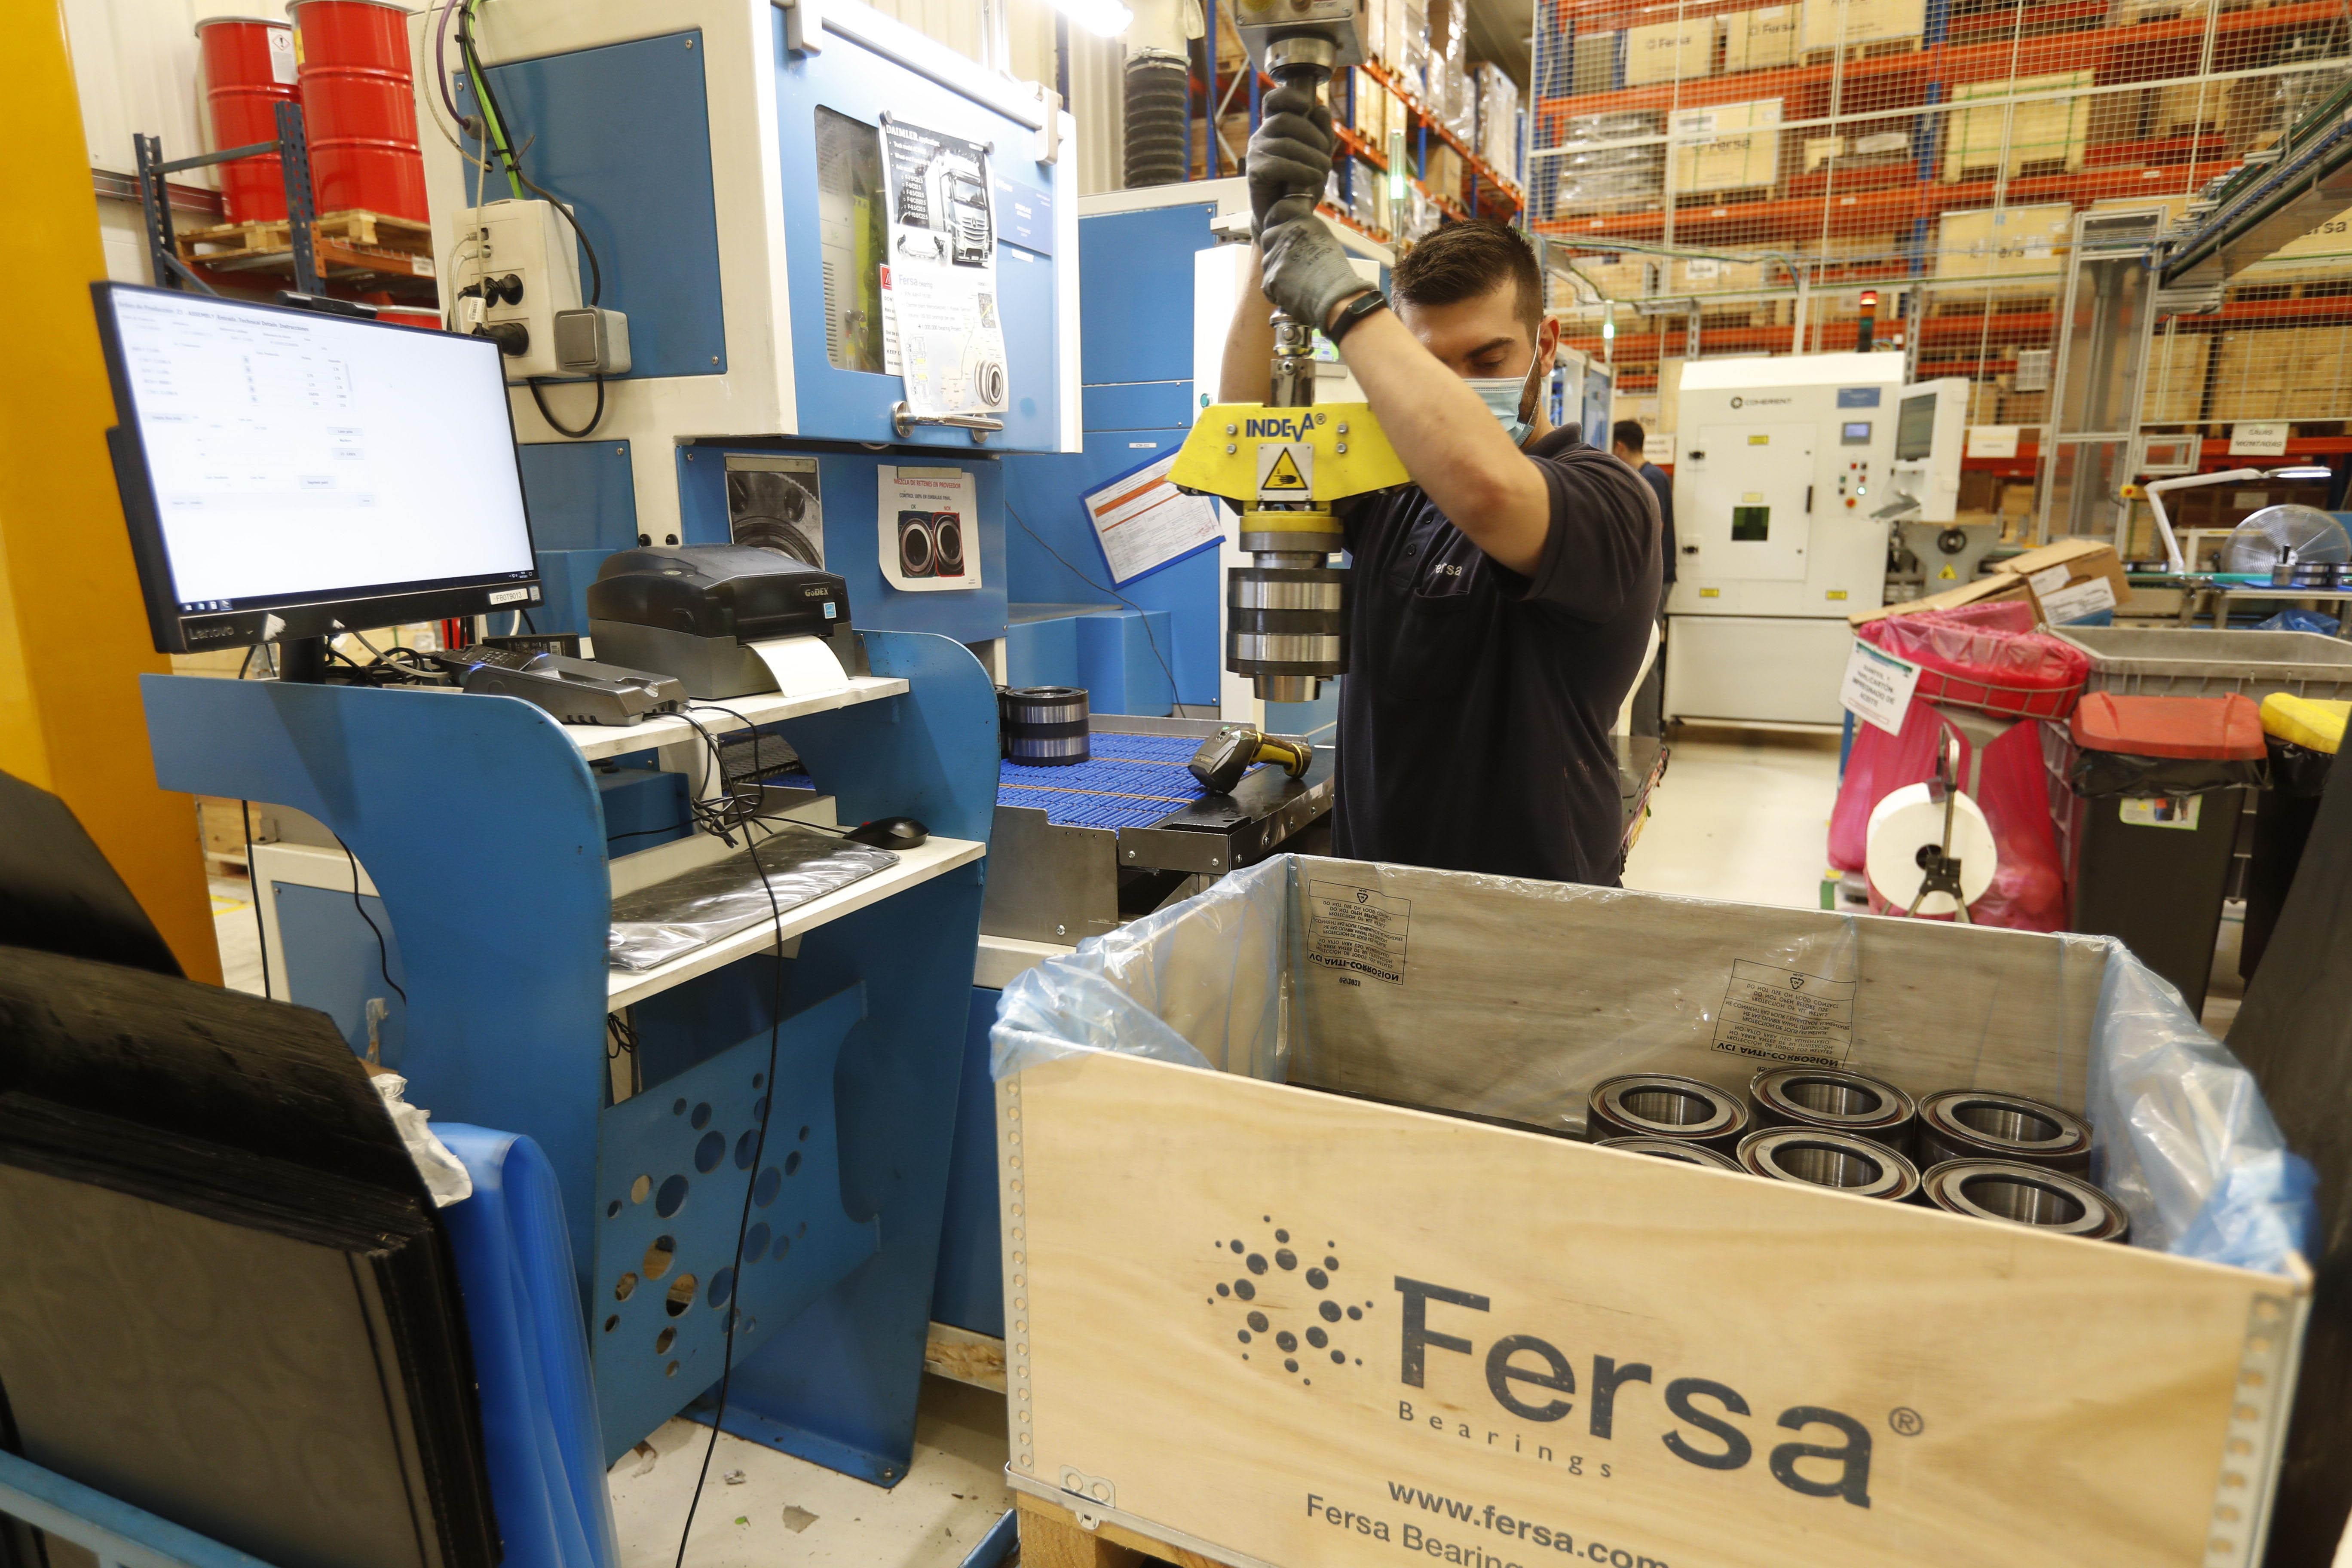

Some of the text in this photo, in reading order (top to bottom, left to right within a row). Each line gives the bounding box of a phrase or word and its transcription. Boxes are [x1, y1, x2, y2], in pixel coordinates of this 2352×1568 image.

[1762, 23, 1795, 34] Fersa
[886, 124, 919, 141] DAIMLER
[1709, 139, 1750, 151] Fersa
[898, 274, 918, 287] Fersa
[1435, 562, 1462, 576] ersa
[1886, 695, 1895, 704] DE
[1399, 1400, 1611, 1478] Bearings
[1307, 1492, 1524, 1568] Fersa Bearin
[1387, 1480, 1669, 1568] www.fersa.com
